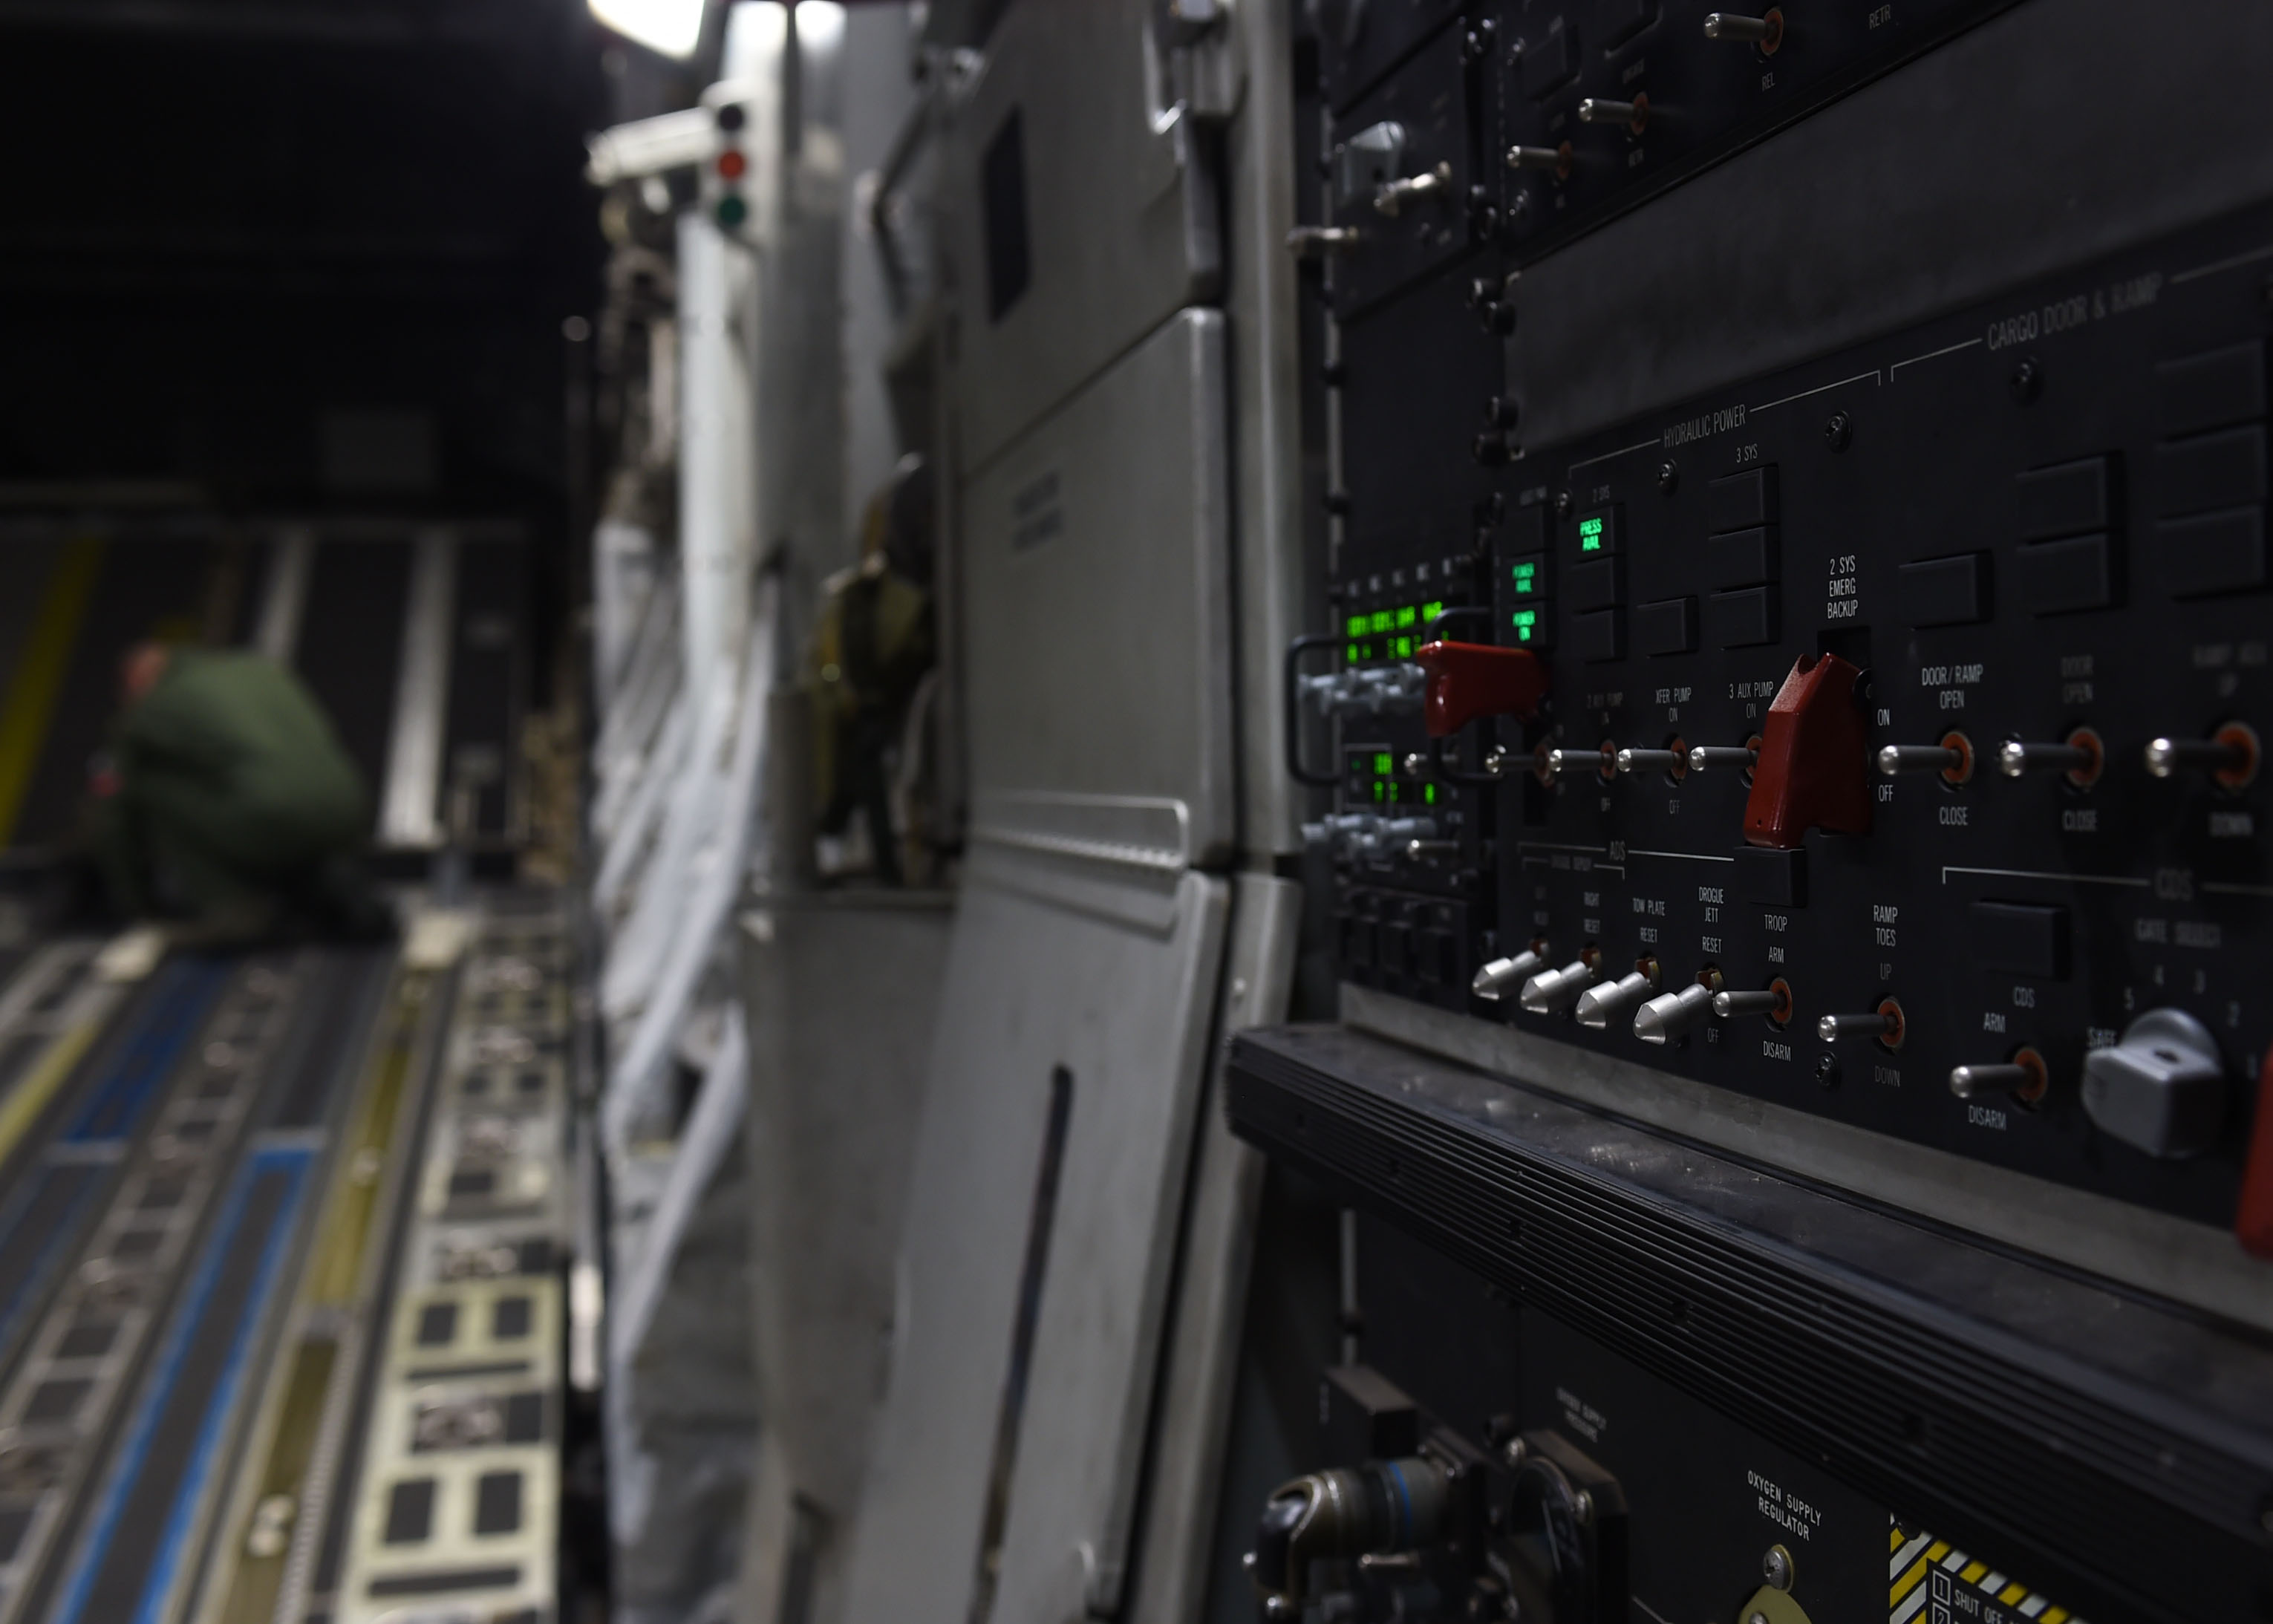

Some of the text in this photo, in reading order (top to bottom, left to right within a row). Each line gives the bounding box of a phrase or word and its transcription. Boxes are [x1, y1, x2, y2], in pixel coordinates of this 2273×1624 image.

[1869, 4, 1892, 30] RETR
[1762, 72, 1775, 92] REL
[1987, 311, 2038, 351] CARGO
[2043, 295, 2088, 336] DOOR
[2110, 270, 2163, 314] RAMP
[1664, 403, 1746, 448] HYDRAULIC POWER
[1736, 443, 1758, 463] 3 SYS
[1579, 518, 1602, 536] PRESS
[1830, 555, 1856, 575] 2 SYS
[1829, 577, 1856, 597] EMERG
[1827, 599, 1858, 619] BACKUP
[1655, 687, 1692, 704] XFER PUMP
[1729, 680, 1774, 700] 3 AUX PUMP
[1940, 690, 1964, 710] OPEN
[1669, 708, 1678, 722] ON
[1747, 702, 1756, 719] ON
[1877, 708, 1890, 727] ON
[1878, 784, 1894, 802] OFF
[1669, 800, 1681, 814] OFF
[1940, 806, 1968, 826] CLOSE
[2062, 809, 2098, 832] CLOSE
[1609, 840, 1626, 861] ADS
[1698, 886, 1724, 904] DROGUE
[1633, 898, 1666, 917] TOW PLATE
[1705, 907, 1718, 924] JETT
[1873, 904, 1898, 924] RAMP
[1764, 914, 1788, 933] TROOP
[1640, 927, 1657, 944] RESET
[1702, 936, 1722, 954] RESET
[1876, 927, 1897, 947] TOES
[1768, 946, 1784, 963] ARM
[1880, 962, 1892, 980] UP
[2013, 986, 2035, 1008] CDS
[2124, 986, 2134, 1011] 5
[1983, 1012, 2006, 1033] ARM
[1708, 1028, 1719, 1043] OFF
[1763, 1040, 1792, 1062] DISARM
[1874, 1065, 1901, 1087] DOWN
[1969, 1104, 2006, 1130] DISARM
[1747, 1470, 1822, 1527] OXYGEN SUPPLY
[1758, 1496, 1810, 1542] REGULATOR
[1954, 1588, 1980, 1617] SHUT
[1984, 1605, 2005, 1624] OFF
